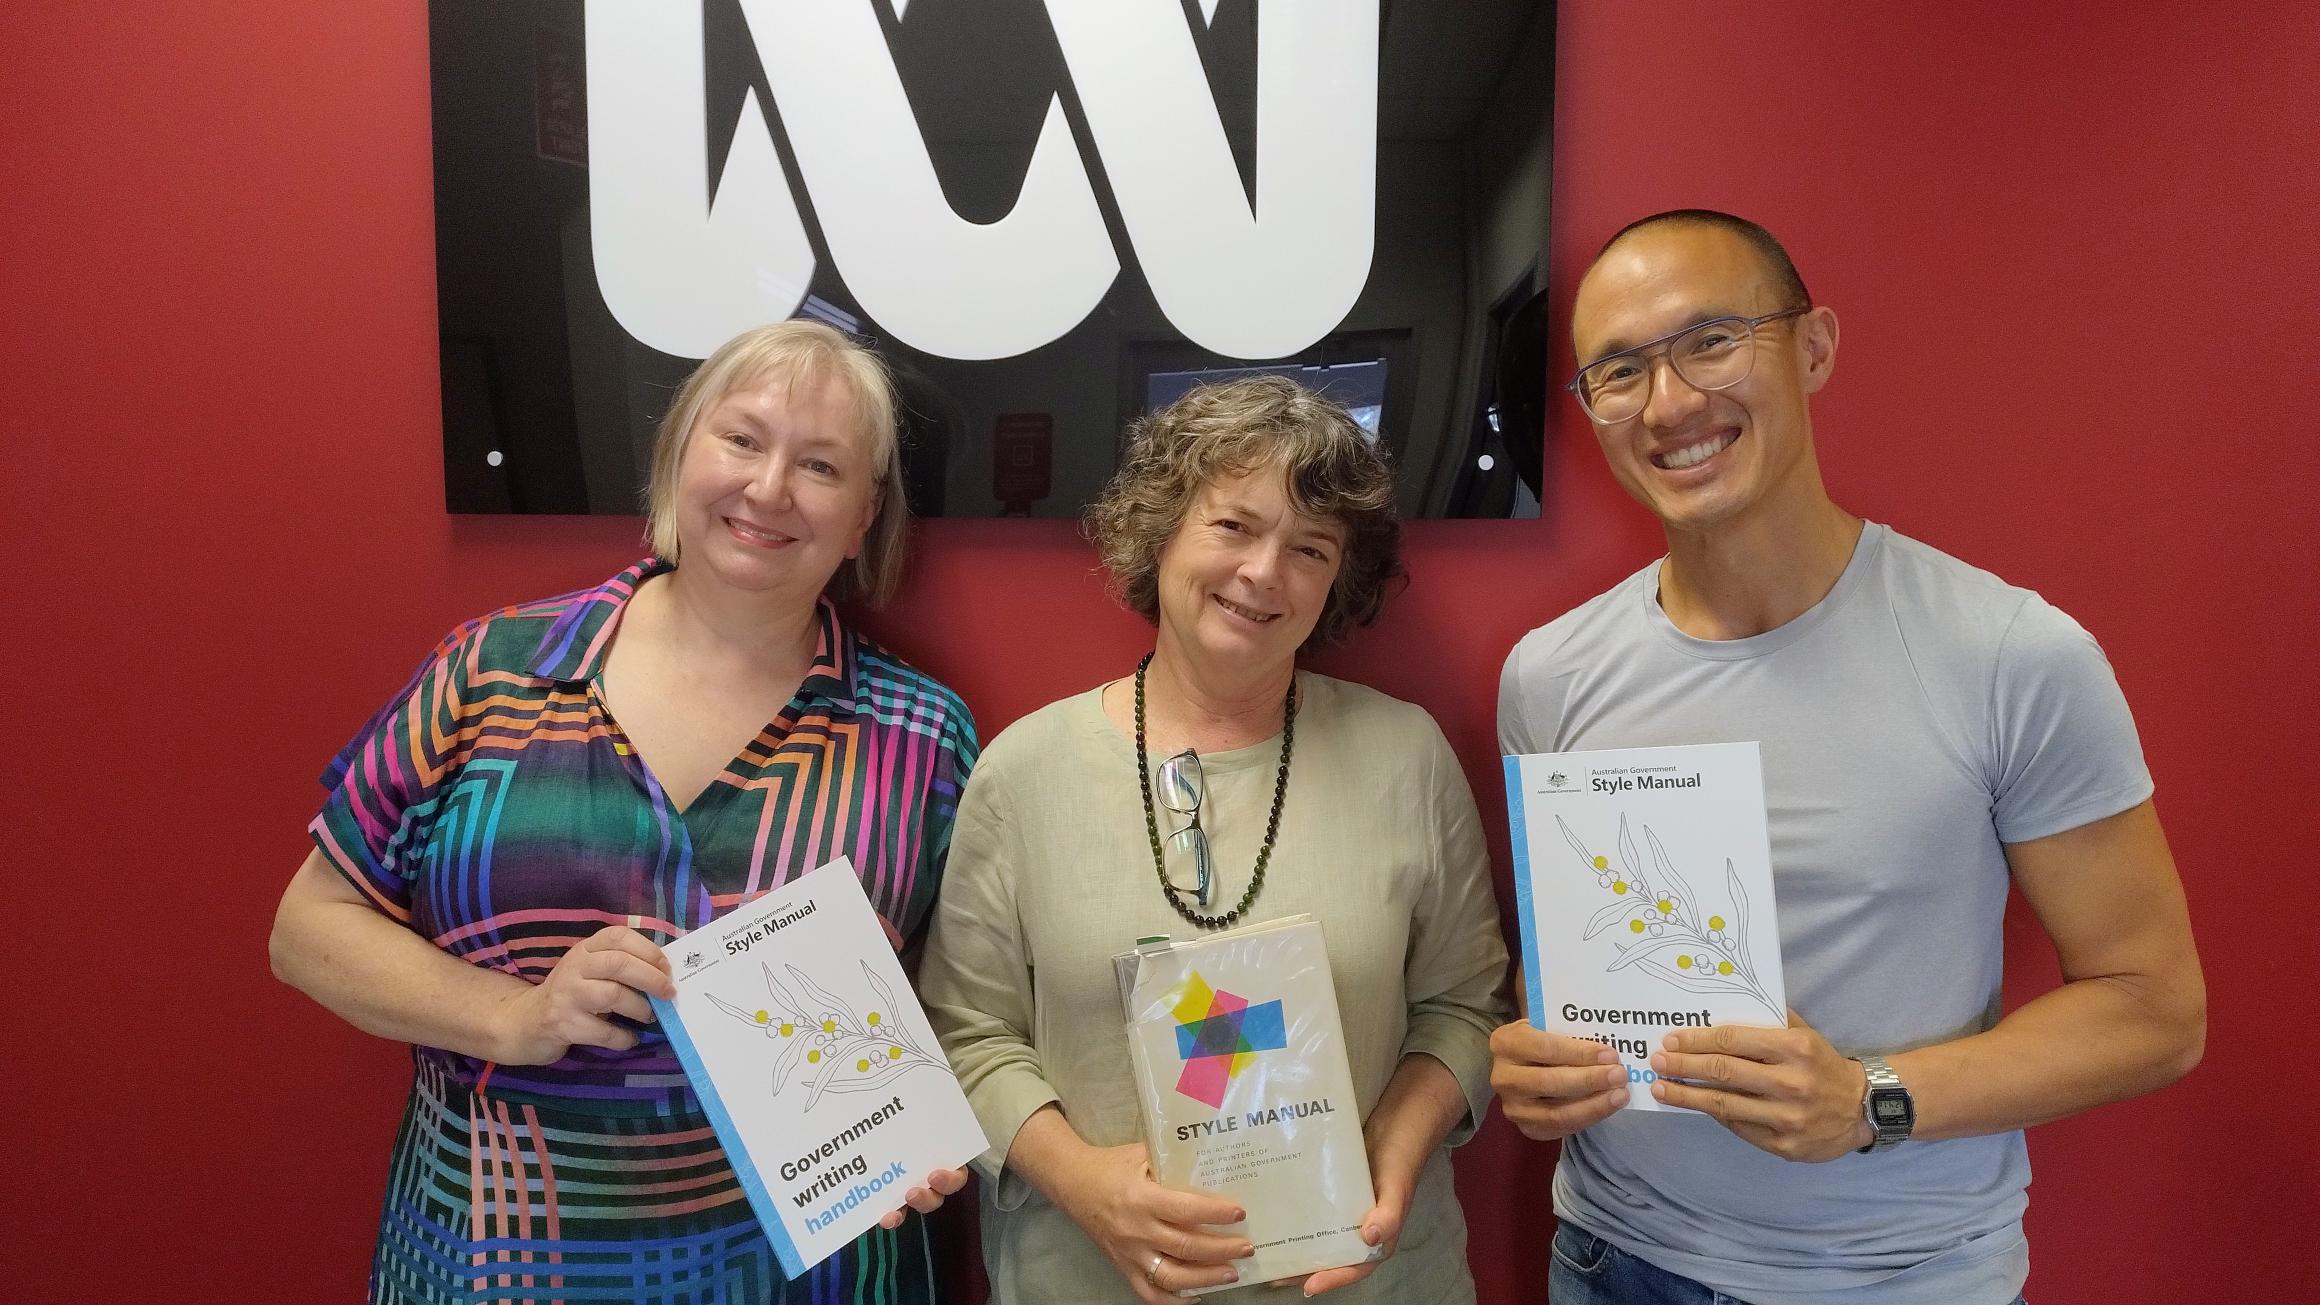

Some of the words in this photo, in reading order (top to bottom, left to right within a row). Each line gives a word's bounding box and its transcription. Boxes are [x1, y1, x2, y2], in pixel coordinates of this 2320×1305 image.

[1591, 768, 1628, 776] Australian
[1629, 765, 1677, 775] Government
[1591, 776, 1633, 795] Style
[1637, 773, 1701, 790] Manual
[722, 923, 754, 942] Australian
[754, 901, 793, 925] Government
[725, 931, 763, 956] Style
[763, 899, 817, 936] Manual
[1562, 1003, 1712, 1028] Government
[1176, 1116, 1238, 1141] STYLE
[1246, 1098, 1335, 1128] MANUAL
[780, 1096, 905, 1182] Government
[1215, 1141, 1251, 1153] AUTHORS
[1198, 1158, 1214, 1167] AND
[1218, 1150, 1255, 1163] PRINTERS
[1200, 1163, 1247, 1177] AUSTRALIAN
[1250, 1152, 1302, 1168] GOVERNMENT
[792, 1154, 868, 1209] writing
[1202, 1171, 1258, 1188] PUBLICATIONS
[804, 1161, 907, 1236] handbook
[1253, 1239, 1286, 1250] overnment
[1288, 1234, 1314, 1243] Printing
[1340, 1224, 1363, 1233] Canber
